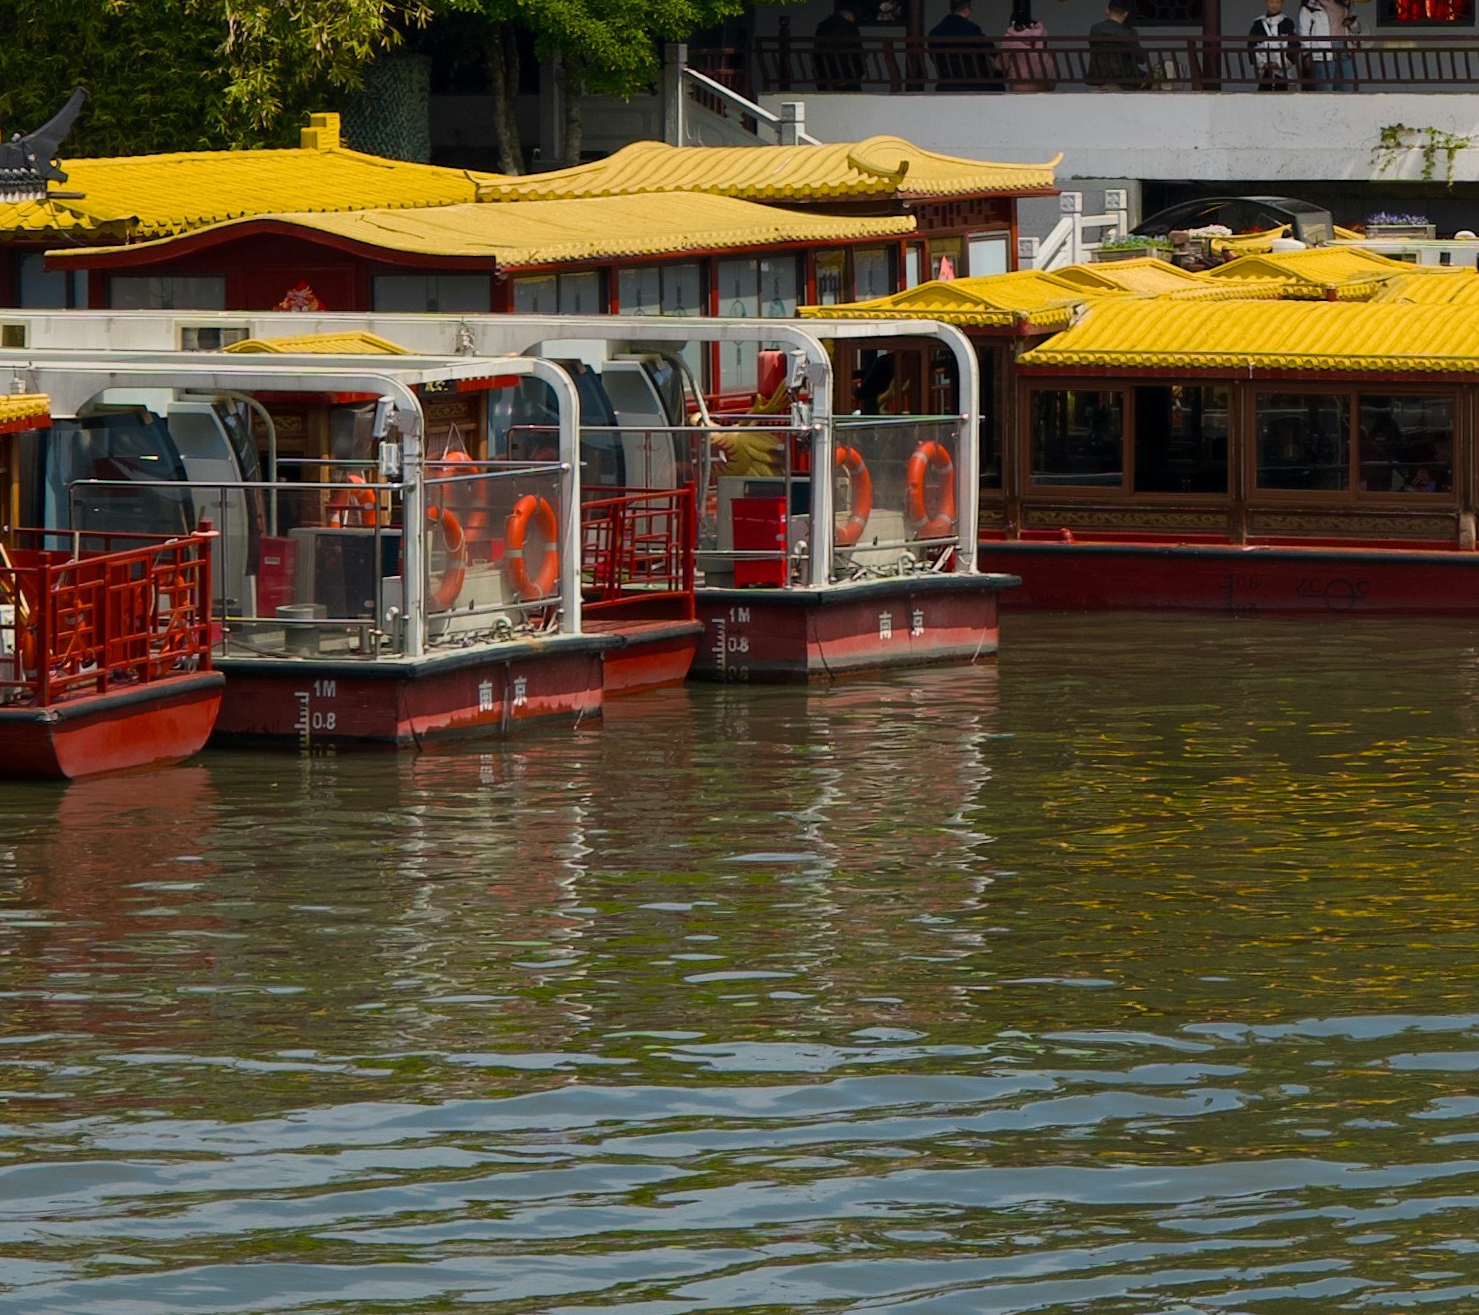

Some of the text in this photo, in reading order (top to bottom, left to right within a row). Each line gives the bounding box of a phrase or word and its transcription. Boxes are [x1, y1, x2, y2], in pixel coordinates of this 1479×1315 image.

[729, 607, 750, 623] 1M
[878, 609, 925, 640] 南京
[728, 637, 750, 653] 0.8
[313, 680, 337, 698] 1M
[478, 676, 528, 712] 南京
[312, 712, 337, 729] 0.8
